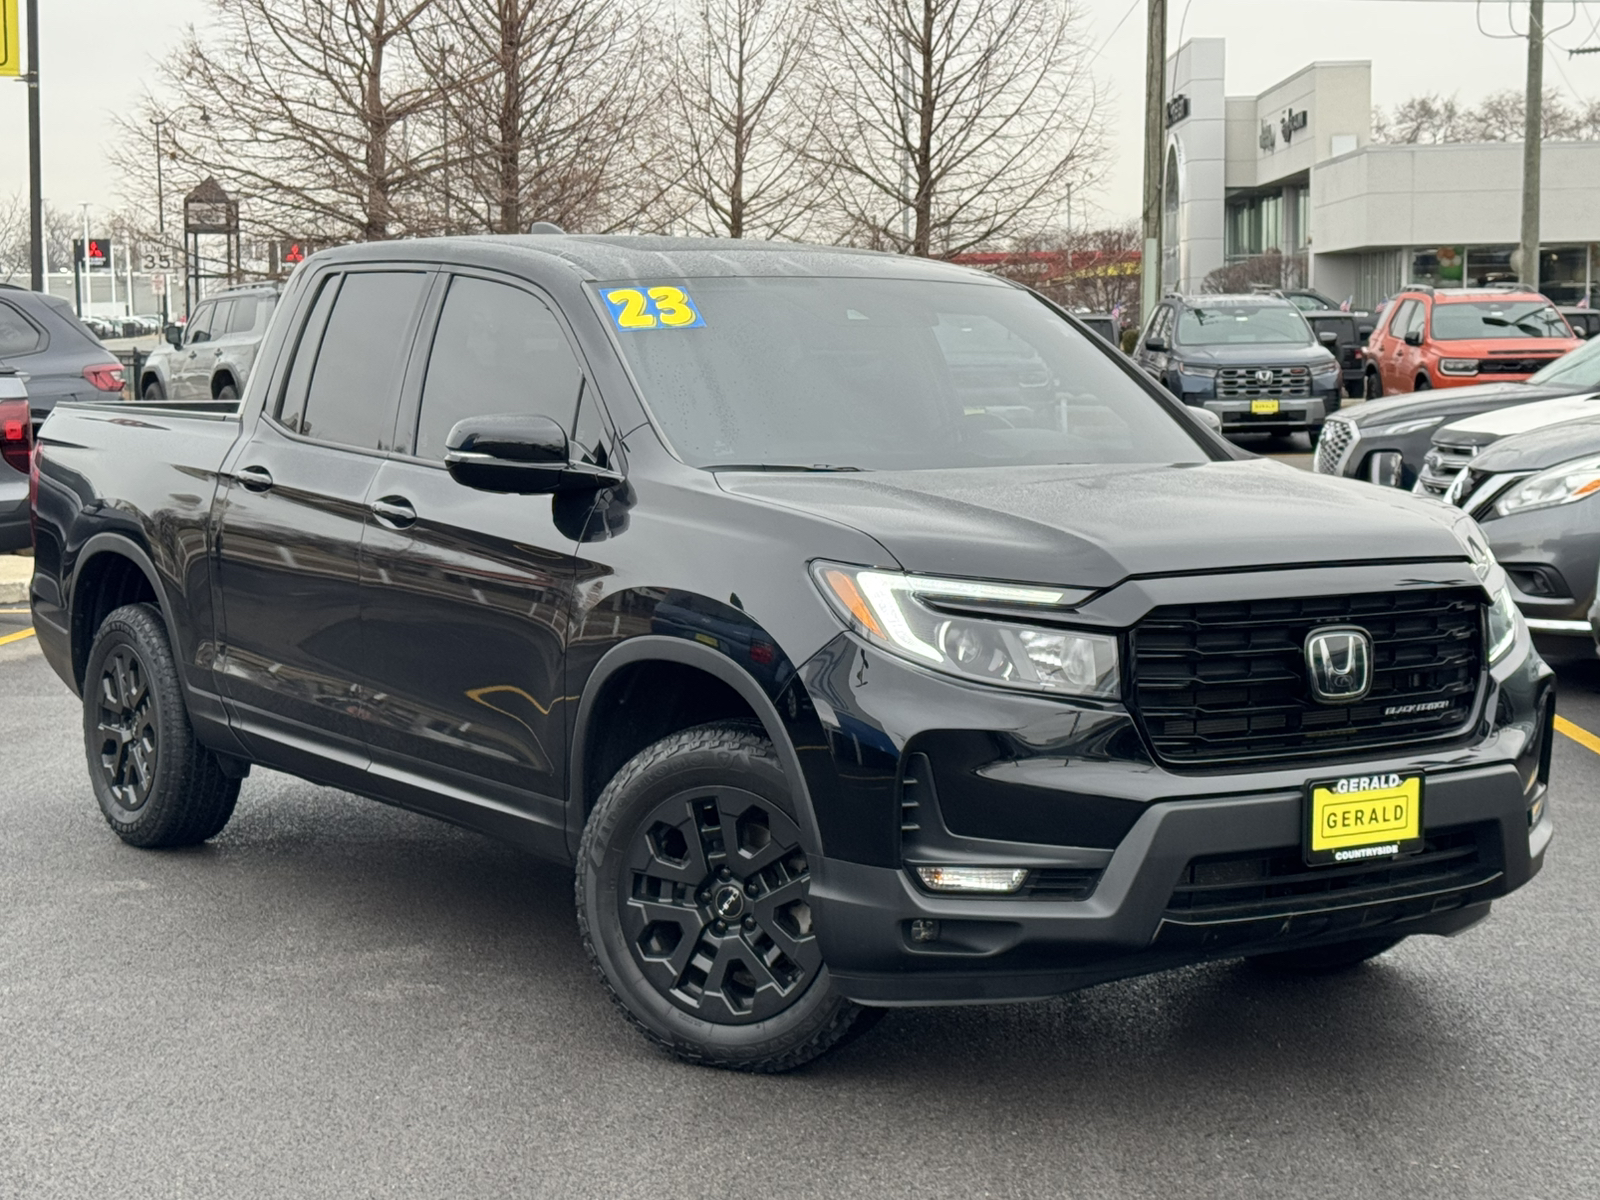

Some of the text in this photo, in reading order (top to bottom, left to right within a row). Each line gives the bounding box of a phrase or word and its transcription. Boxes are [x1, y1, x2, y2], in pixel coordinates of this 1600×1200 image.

[144, 254, 170, 269] 35
[607, 286, 697, 328] 23
[1337, 774, 1399, 793] GERALD
[1326, 804, 1404, 829] GERALD
[1335, 844, 1399, 861] COUNTRYSIDE
